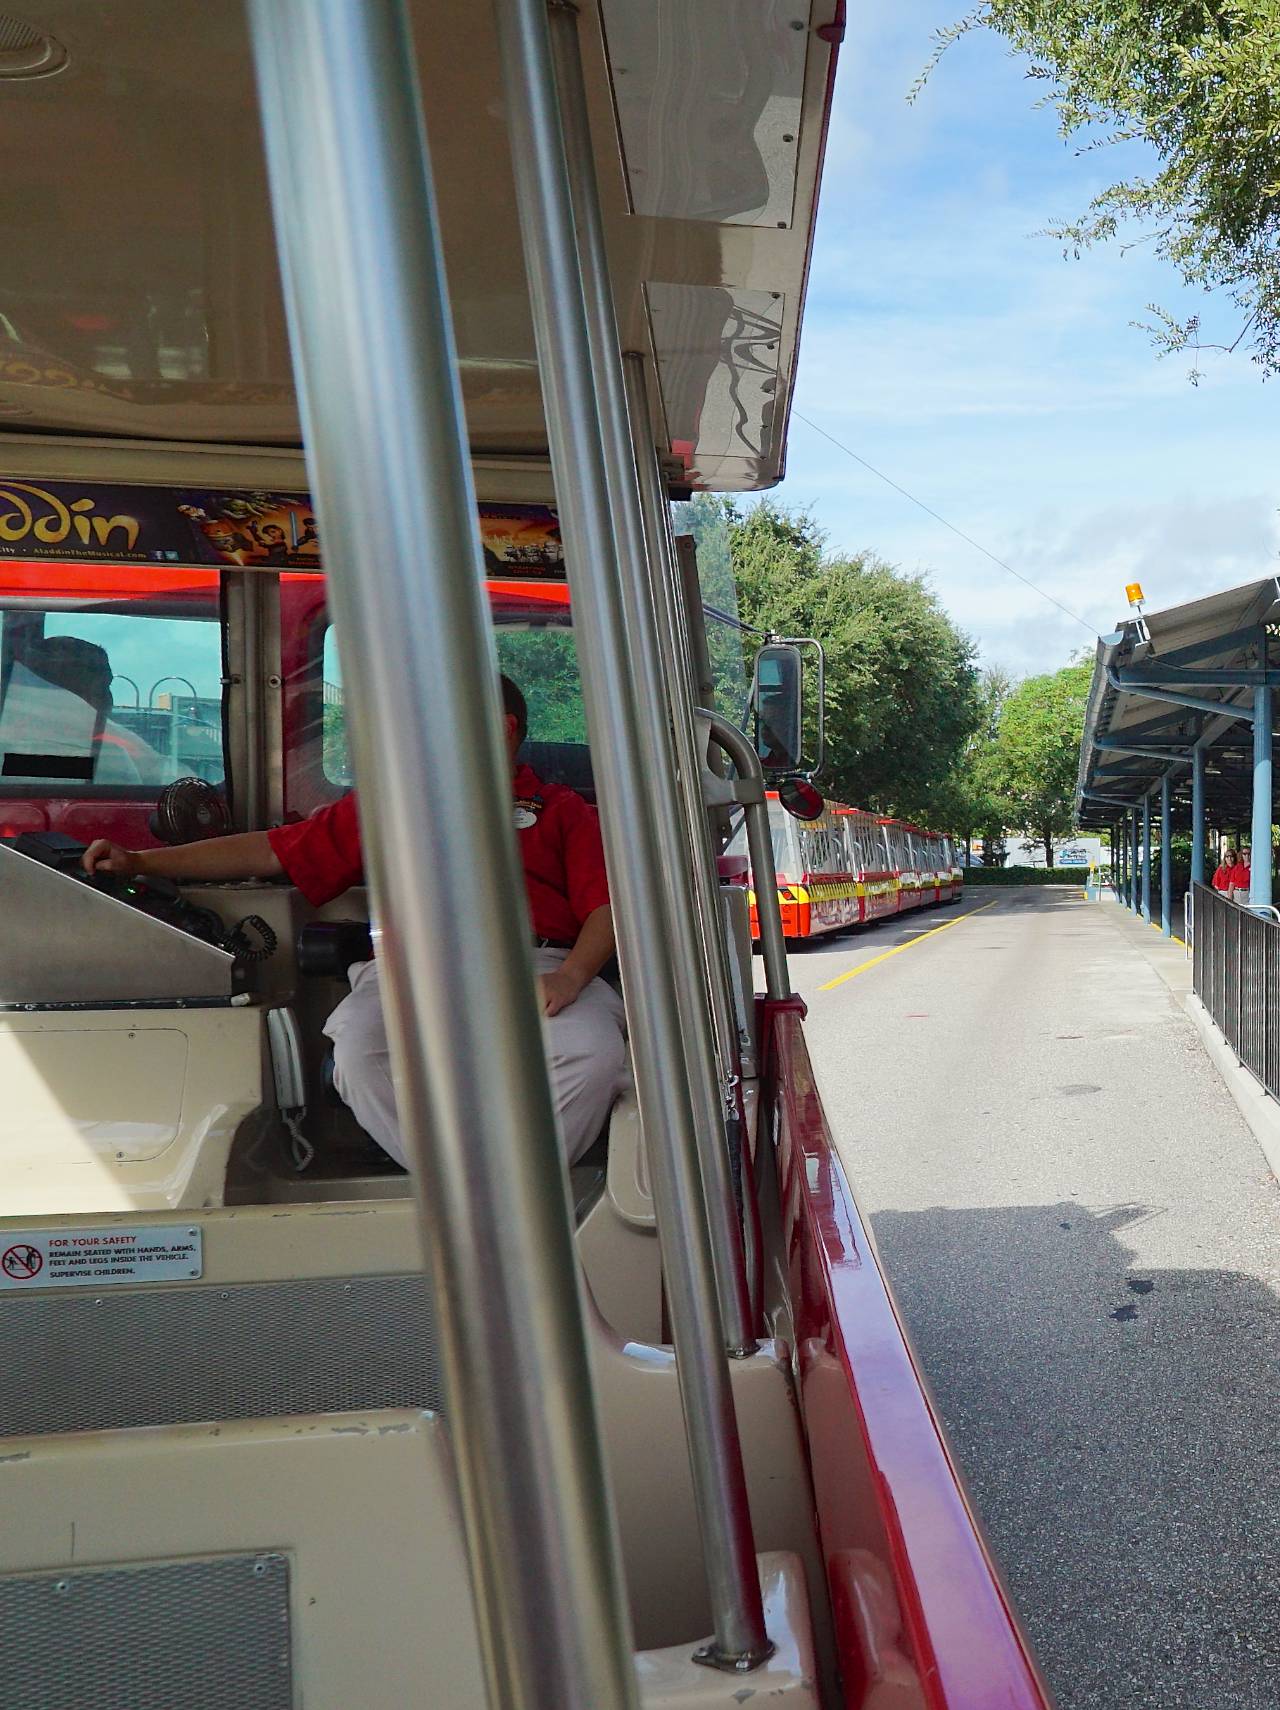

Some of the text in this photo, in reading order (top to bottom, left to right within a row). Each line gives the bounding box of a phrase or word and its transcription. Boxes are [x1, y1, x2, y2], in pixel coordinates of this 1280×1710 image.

[33, 547, 147, 560] AladdinTheMusical.com
[49, 1236, 137, 1247] FOR YOUR SAFETY
[49, 1250, 81, 1258] REMAIN
[114, 1247, 135, 1255] WITH
[49, 1259, 66, 1267] FEET
[89, 1257, 108, 1265] LEGS
[111, 1255, 137, 1263] INSIDE
[139, 1254, 153, 1262] THE
[50, 1269, 91, 1278] SUPERVISE
